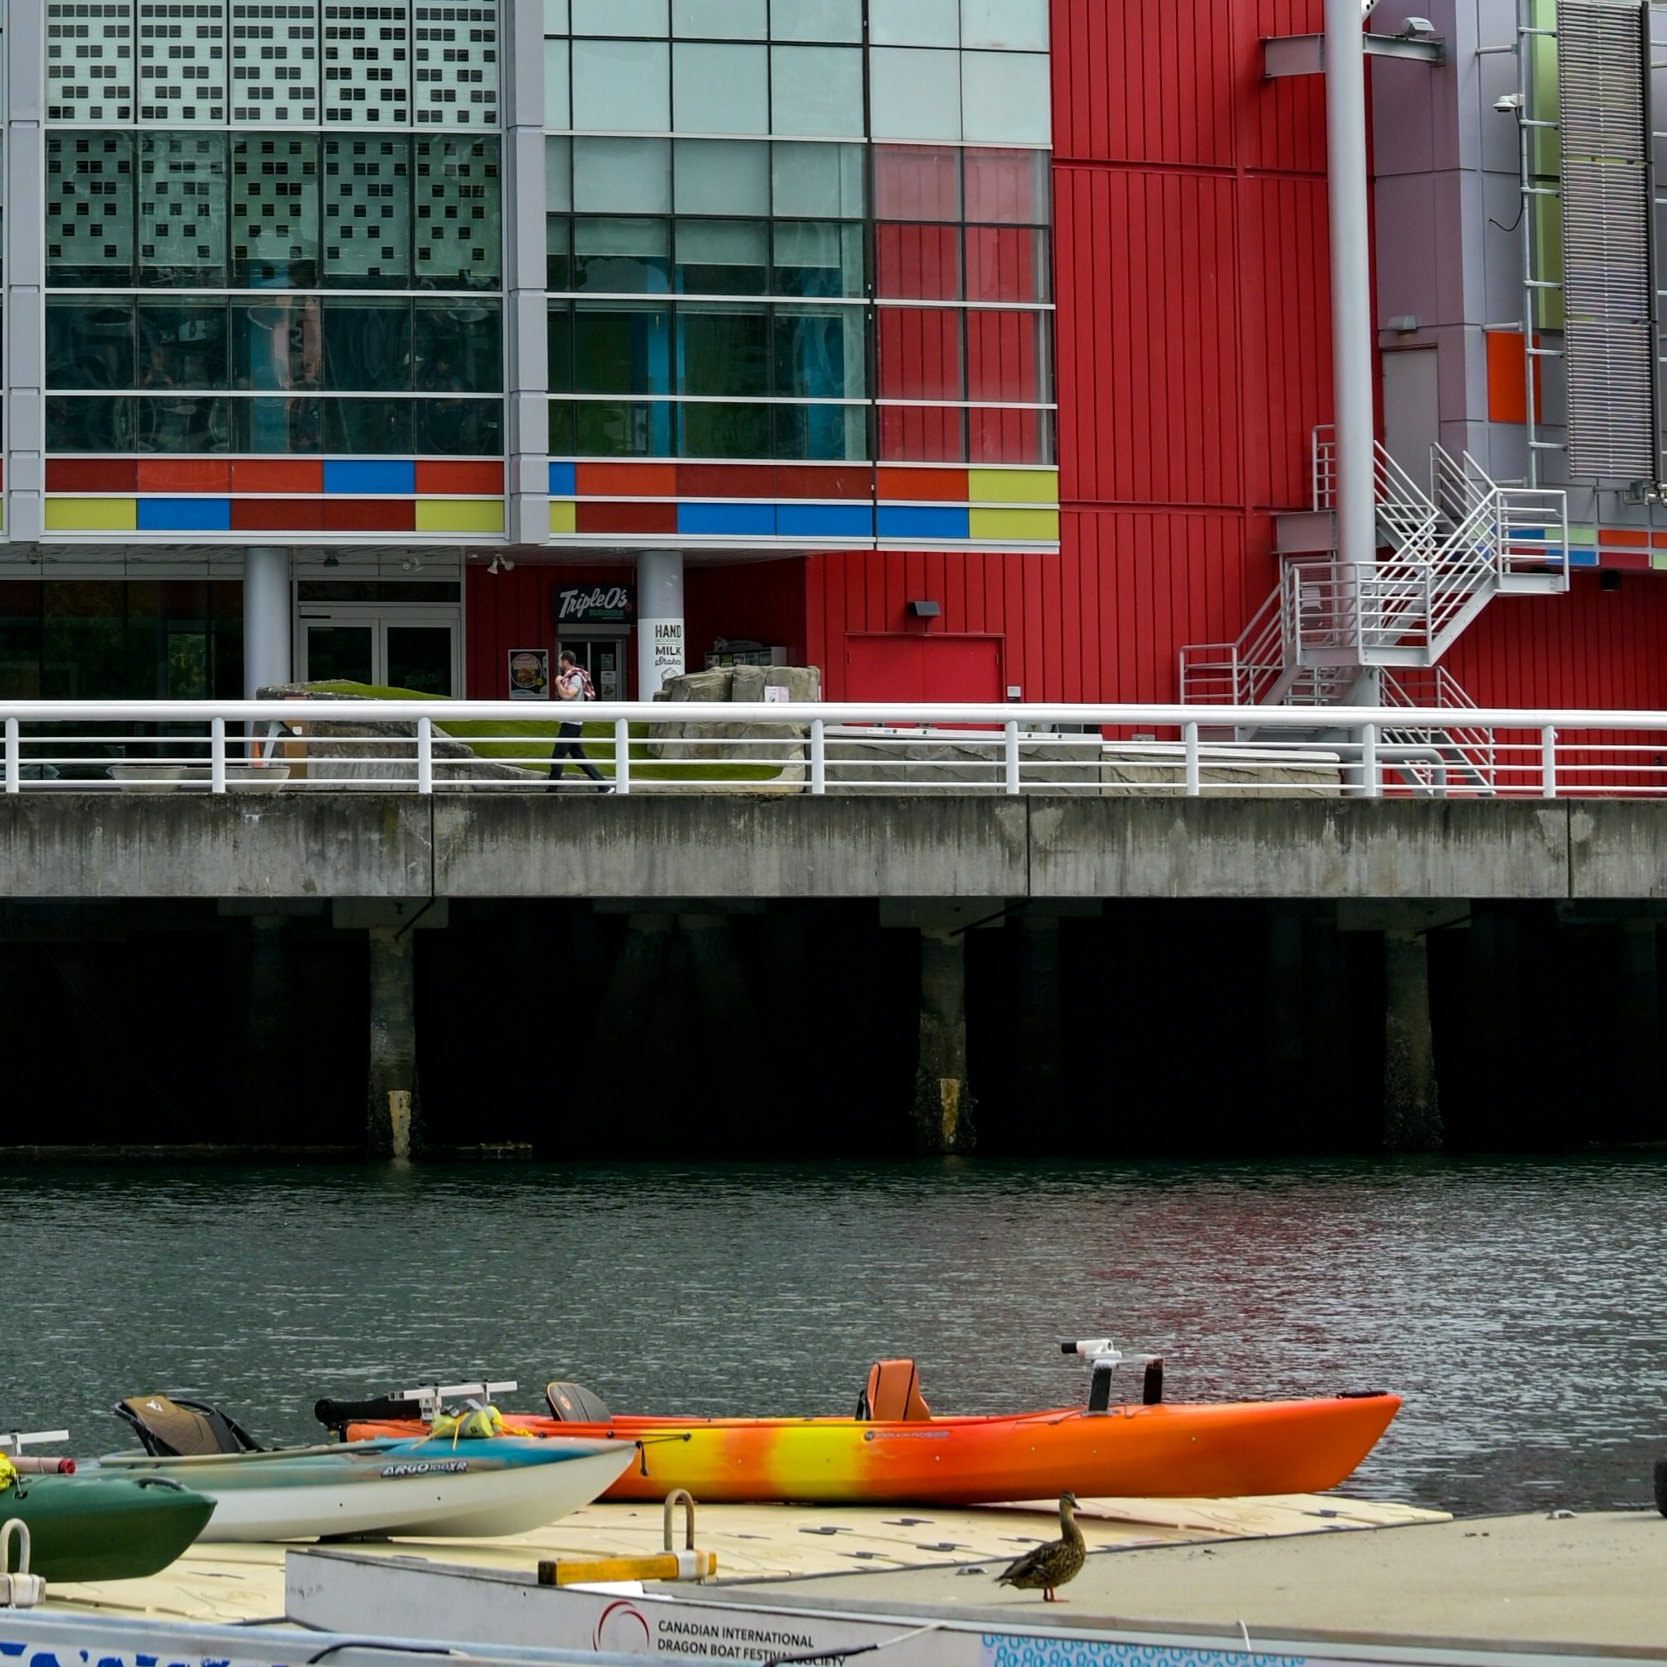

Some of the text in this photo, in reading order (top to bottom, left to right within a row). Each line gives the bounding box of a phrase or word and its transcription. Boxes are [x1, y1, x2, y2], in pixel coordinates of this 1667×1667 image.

[655, 625, 681, 638] HAND
[655, 646, 681, 655] MILK
[658, 1620, 814, 1647] CANADIAN INTERNATIONAL
[657, 1638, 708, 1655] DRAGON
[710, 1643, 741, 1658] BOAT
